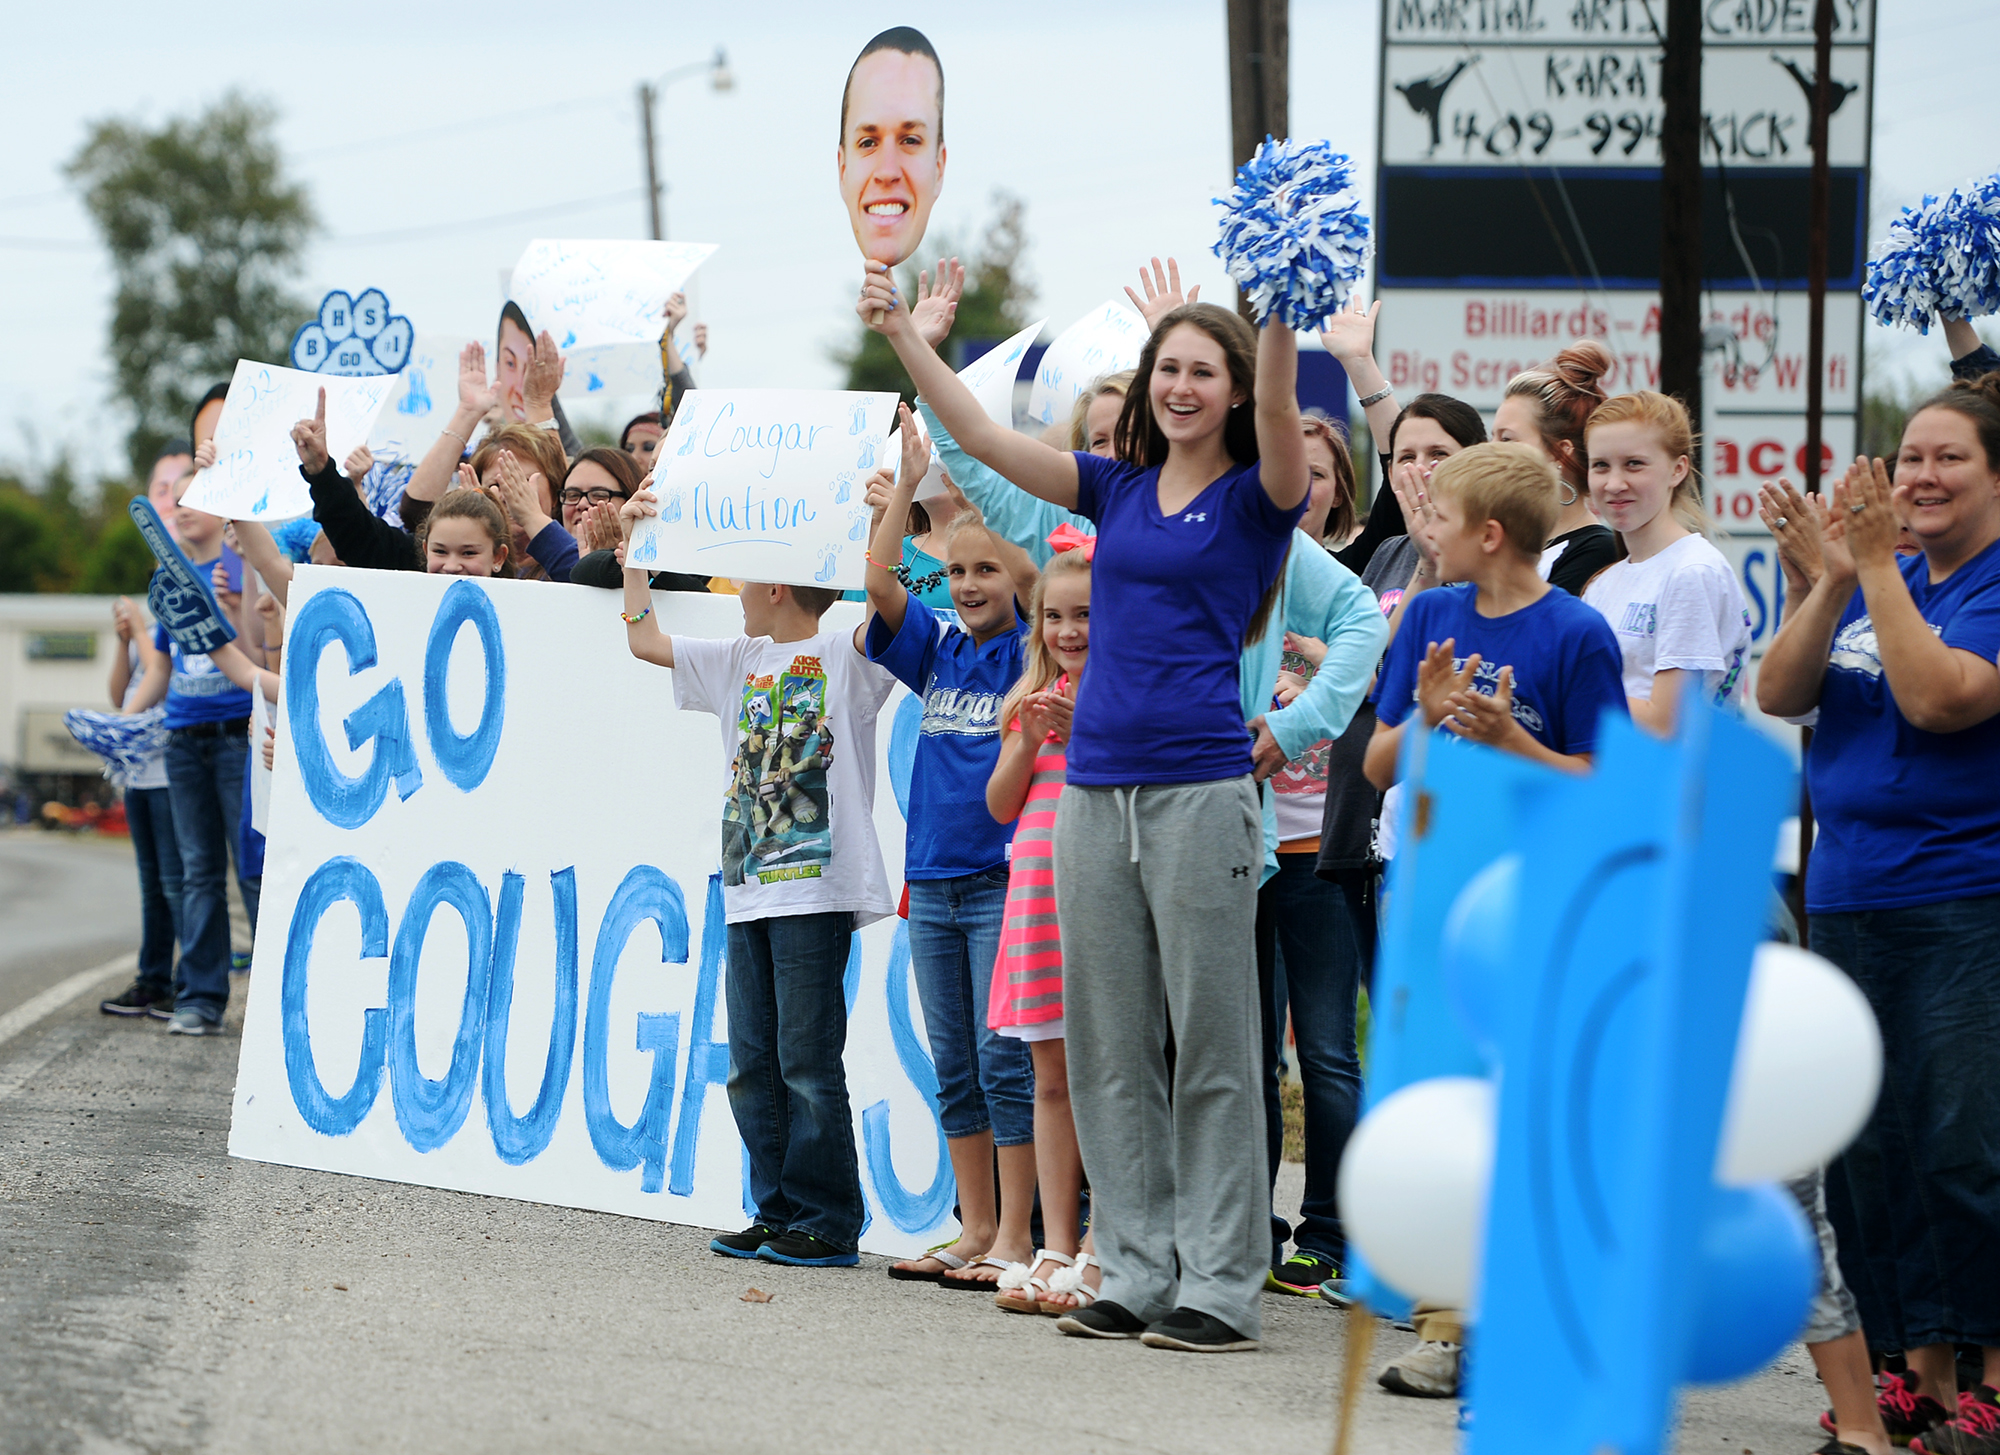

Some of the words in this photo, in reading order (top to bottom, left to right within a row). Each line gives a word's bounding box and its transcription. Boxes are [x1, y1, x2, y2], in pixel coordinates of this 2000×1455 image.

[1397, 0, 1546, 31] MARTIAL
[1701, 0, 1860, 34] CADEY
[1547, 54, 1664, 97] KARA
[340, 352, 360, 368] GO
[1390, 351, 1440, 393] Big
[704, 402, 833, 478] Cougar
[790, 664, 823, 678] BUTT!
[792, 654, 822, 668] KICK
[286, 579, 505, 830] GO
[757, 864, 822, 885] TURTLES
[281, 855, 957, 1236] COUGAS
